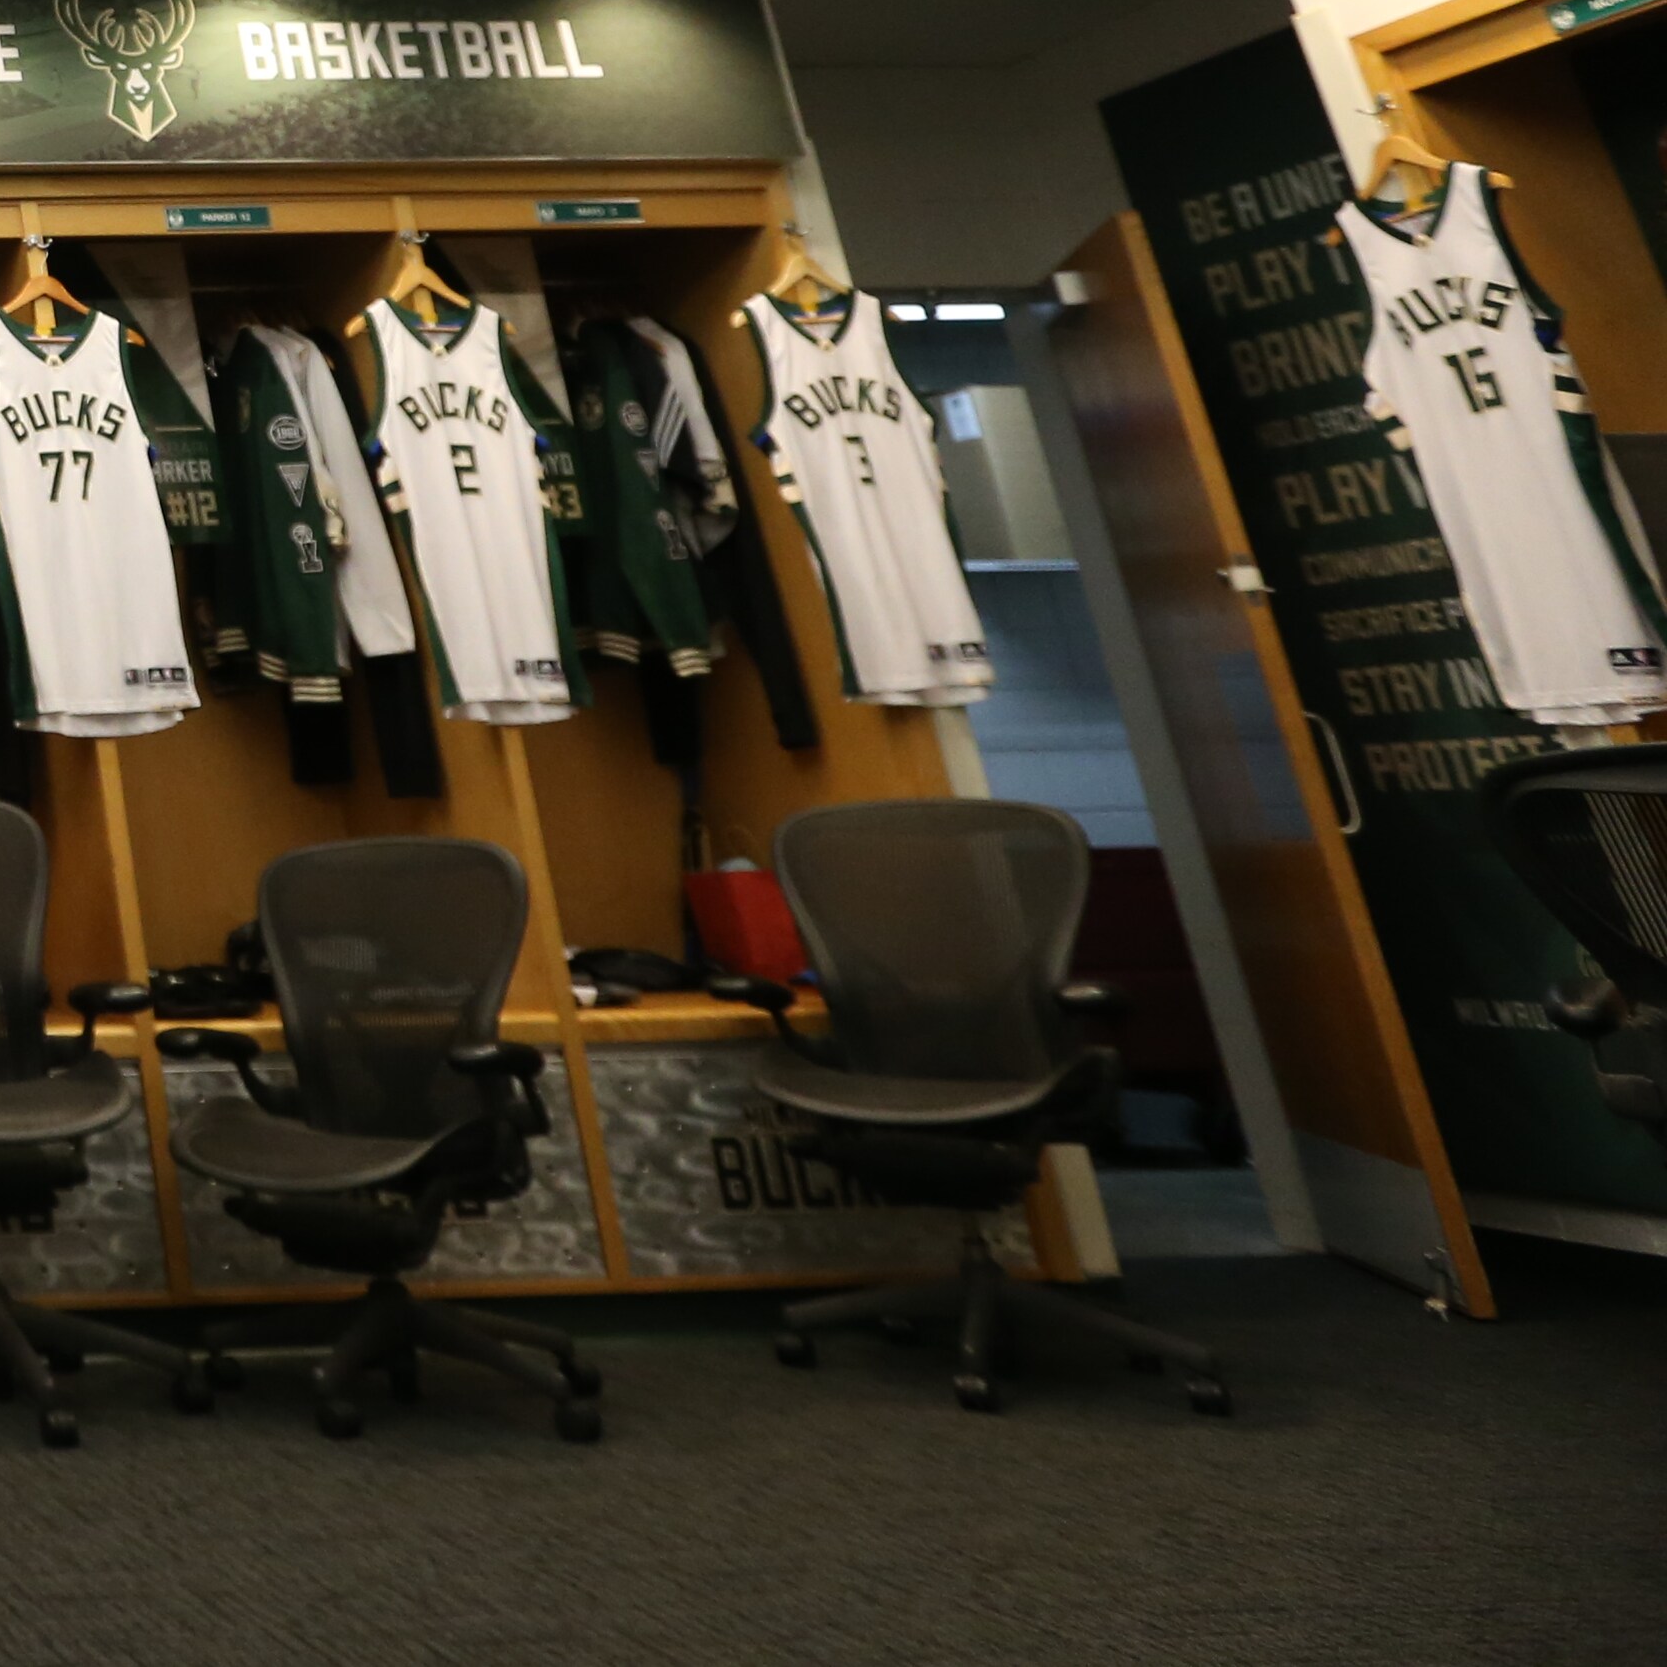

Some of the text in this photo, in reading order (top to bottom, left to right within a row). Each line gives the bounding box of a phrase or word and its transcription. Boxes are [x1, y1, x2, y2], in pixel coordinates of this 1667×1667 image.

[238, 19, 605, 81] BASKETBALL
[1178, 192, 1234, 244] BE
[1229, 182, 1266, 231] A
[1203, 232, 1352, 318] PLAY T
[0, 390, 128, 445] BUCKS
[783, 374, 903, 430] BUCKS
[38, 450, 95, 503] 77
[153, 457, 214, 483] ARKER
[448, 443, 483, 497] 2
[1274, 458, 1393, 530] PLAY
[166, 488, 221, 527] #12
[1338, 661, 1444, 718] STAY
[712, 1137, 884, 1210] BUC
